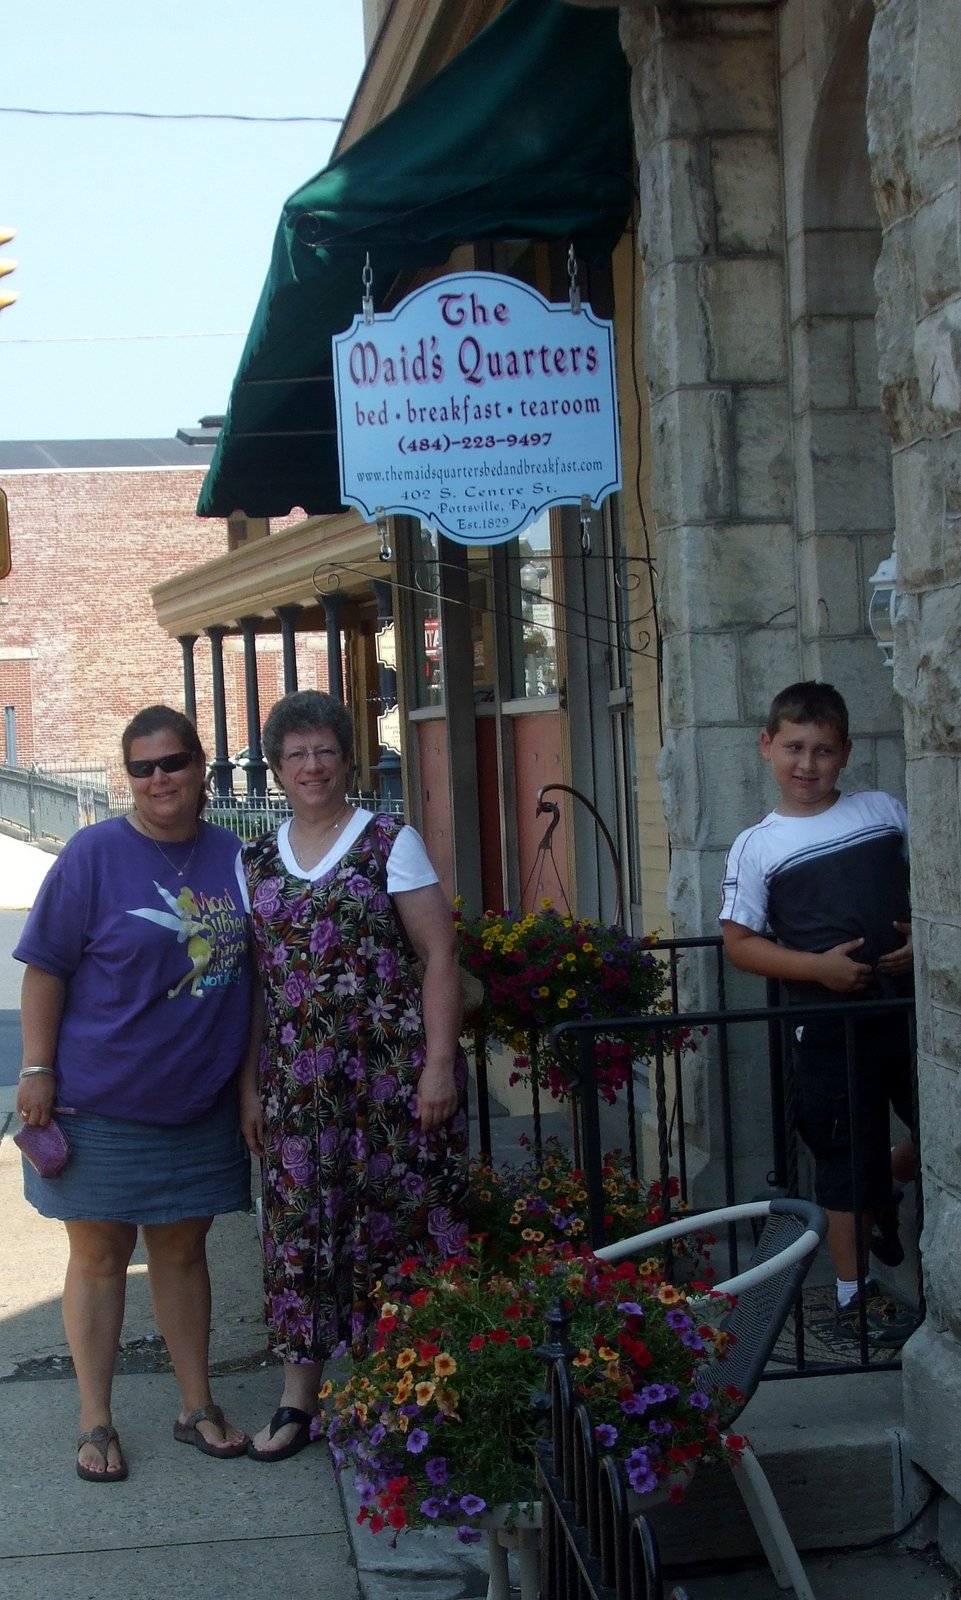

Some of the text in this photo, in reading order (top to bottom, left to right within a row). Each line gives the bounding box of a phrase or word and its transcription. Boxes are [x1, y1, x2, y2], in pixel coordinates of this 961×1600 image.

[438, 293, 511, 327] The
[349, 335, 601, 388] Maid's Quarters
[355, 395, 602, 427] bed breakfast tearoom
[397, 431, 553, 456] (484)-223-9497
[356, 456, 603, 485] www.themaidsquartersbedandbreakfast.com
[400, 481, 558, 501] 402 S. Centre St.
[437, 498, 527, 515] Pottsville, Pa
